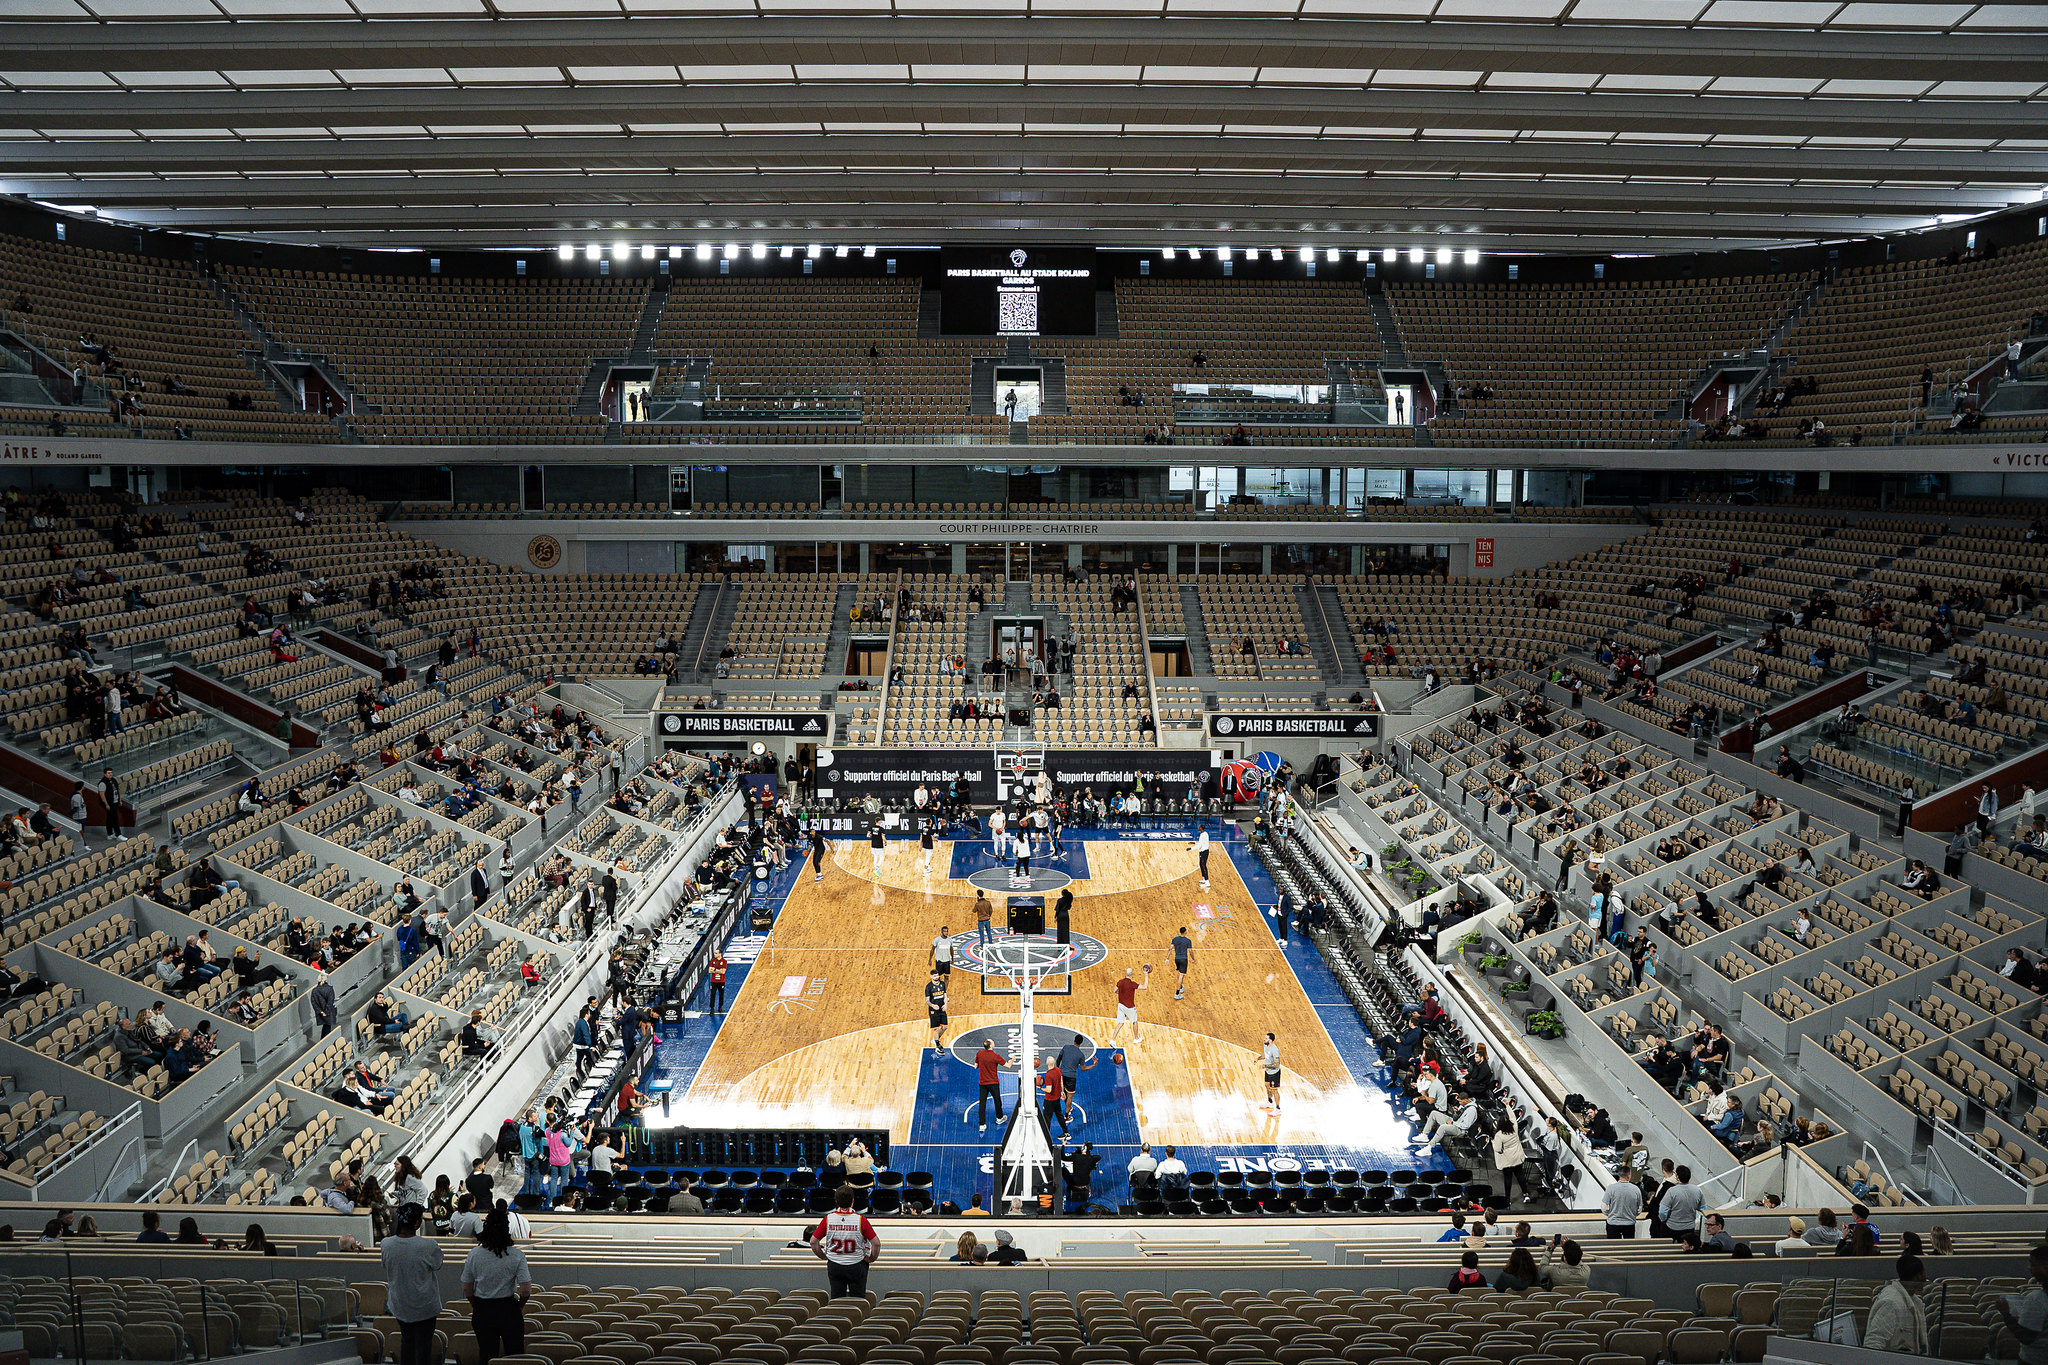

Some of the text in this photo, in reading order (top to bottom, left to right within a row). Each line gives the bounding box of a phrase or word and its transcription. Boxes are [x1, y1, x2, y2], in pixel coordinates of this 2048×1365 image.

[947, 269, 1090, 277] PARIS BASKETBALL AU STADE ROLAND
[1002, 277, 1035, 285] GARROS
[0, 443, 38, 459] ÂTRE
[939, 524, 979, 533] COURT
[982, 524, 1032, 533] PHILIPPE
[1042, 524, 1098, 533] CHATRIER
[1478, 541, 1492, 550] TEN
[1478, 555, 1491, 564] NIS
[685, 718, 720, 730] PARIS
[723, 718, 795, 731] BASKETBALL
[1238, 719, 1273, 732] PARIS
[1276, 719, 1347, 732] BASKETBALL
[843, 770, 882, 783] Supporter
[883, 769, 910, 782] officiel
[911, 770, 921, 782] du
[921, 770, 941, 782] Paris
[1056, 770, 1095, 784] Supporter
[1095, 770, 1123, 783] officiel
[1123, 771, 1133, 783] du
[810, 818, 830, 831] 25/10
[832, 818, 853, 831] 20:00
[900, 818, 909, 831] VS
[1215, 1157, 1356, 1173] THE ONE
[830, 1238, 856, 1254] 20
